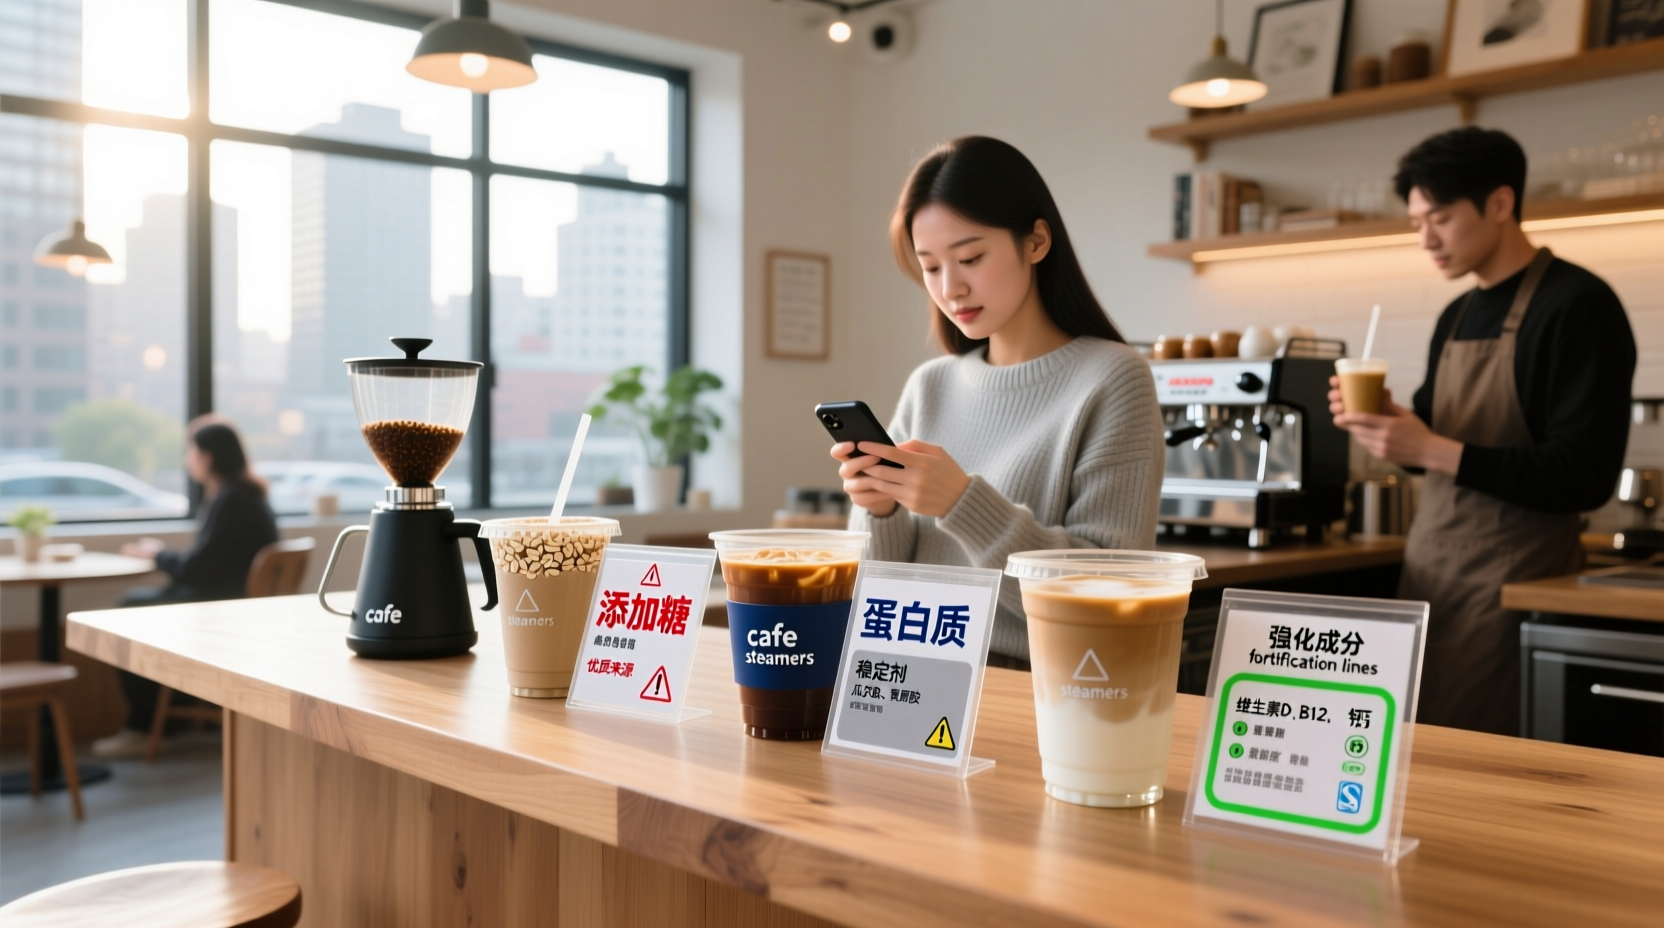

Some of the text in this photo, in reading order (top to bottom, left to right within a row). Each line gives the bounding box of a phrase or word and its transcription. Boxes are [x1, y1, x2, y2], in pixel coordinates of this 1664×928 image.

[365, 603, 402, 624] cafe
[596, 590, 693, 636] 添加糖
[860, 597, 971, 649] 蛋白质
[747, 622, 798, 648] cafe
[1268, 624, 1365, 656] 强化成分
[745, 649, 815, 666] steamers
[1249, 648, 1379, 676] fortification lines
[1060, 684, 1129, 700] steamers
